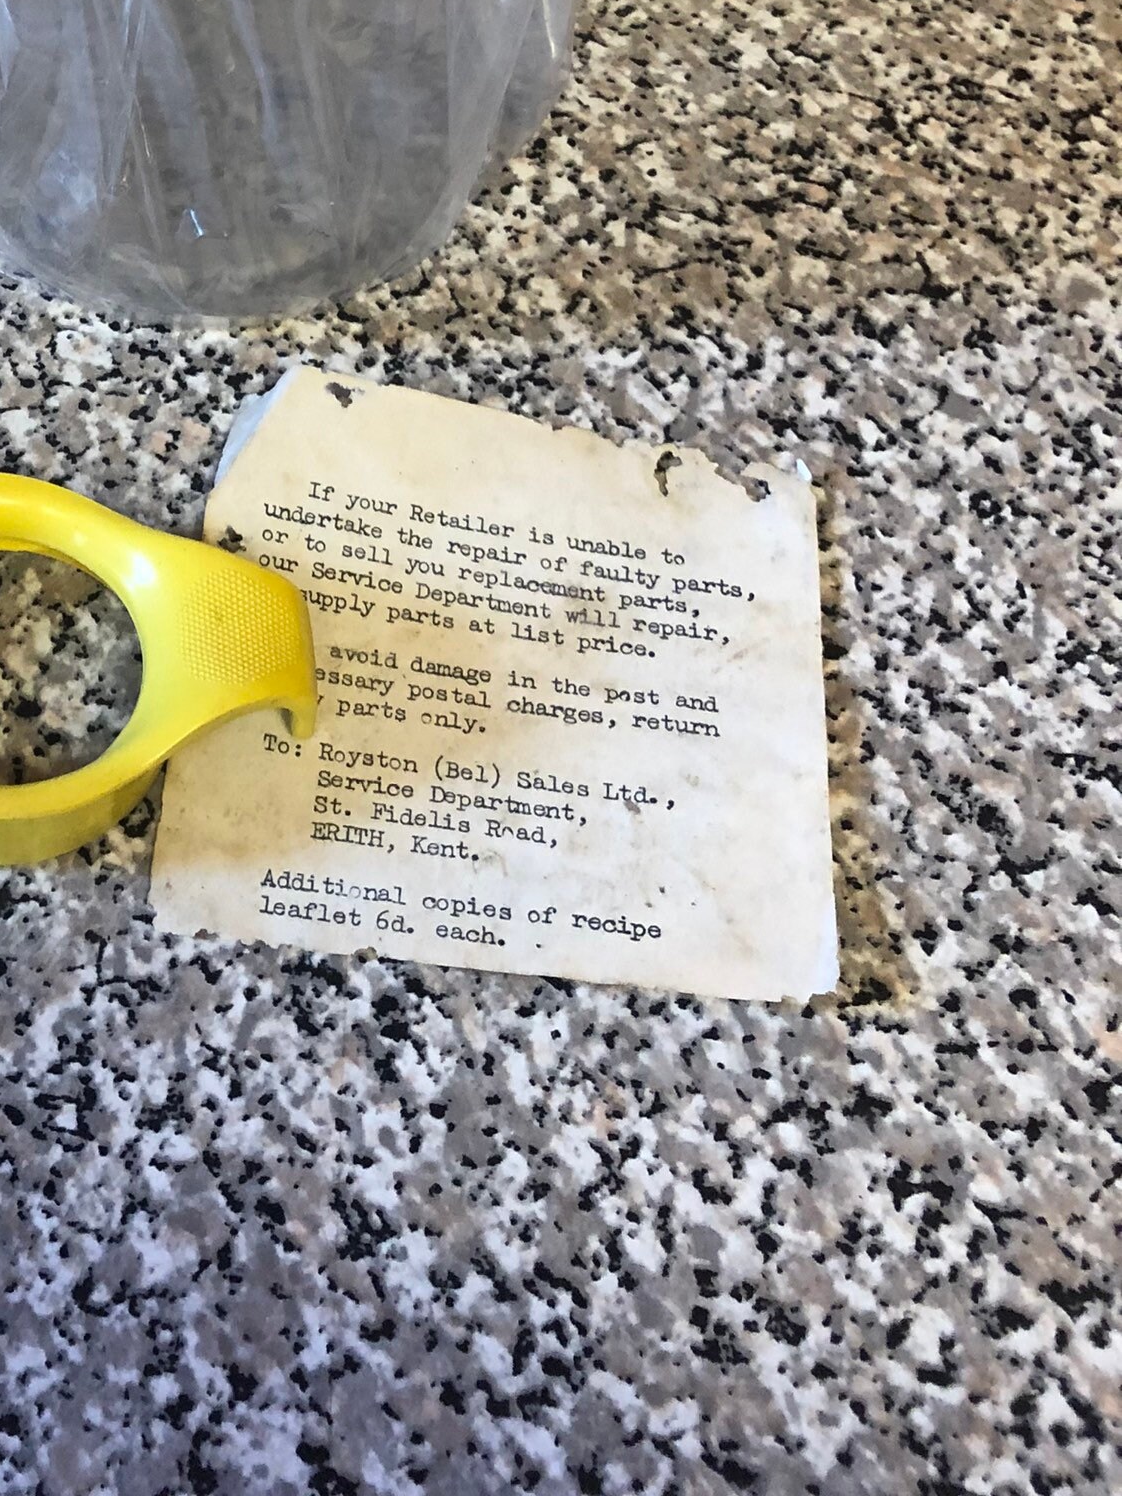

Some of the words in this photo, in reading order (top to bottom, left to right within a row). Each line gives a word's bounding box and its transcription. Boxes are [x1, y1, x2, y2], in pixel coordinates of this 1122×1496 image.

[264, 502, 382, 538] undertake
[397, 527, 433, 549] the
[446, 539, 527, 565] repair
[540, 557, 567, 572] of
[580, 560, 661, 589] faulty
[672, 577, 755, 602] parts,
[308, 482, 335, 502] If
[345, 493, 398, 515] your
[410, 504, 515, 537] Retailer
[529, 527, 554, 545] is
[566, 535, 647, 560] unable
[661, 548, 685, 566] to
[259, 554, 299, 573] our
[311, 561, 404, 594] Service
[415, 582, 551, 619] Department
[566, 608, 621, 629] will
[632, 618, 730, 645] repair,
[262, 529, 289, 545] or
[305, 535, 326, 553] to
[341, 543, 393, 566] sell
[405, 557, 445, 577] you
[458, 567, 605, 602] replacement
[618, 594, 699, 618] parts,
[386, 605, 454, 629] parts
[469, 618, 495, 635] at
[511, 622, 564, 645] list
[578, 635, 656, 658] price.
[330, 646, 398, 669] avoid
[410, 656, 492, 685] damage
[508, 671, 537, 690] in
[552, 677, 591, 697] the
[604, 686, 660, 705] post
[675, 694, 719, 713] and
[336, 698, 407, 722] parts
[421, 711, 486, 734] only.
[407, 682, 491, 708] postal
[507, 696, 616, 729] charges,
[631, 712, 720, 738] return
[263, 733, 302, 757] To:
[318, 742, 418, 774] Royston
[434, 755, 501, 789] (Bel)
[516, 771, 590, 797] Sales
[313, 795, 352, 816] St.
[370, 802, 470, 833] Fidelis
[317, 770, 414, 799] Service
[429, 785, 586, 826] Department,
[310, 821, 395, 854] ERITH,
[410, 835, 480, 862] Kent.
[259, 895, 362, 927] leaflet
[377, 910, 415, 934] 6d.
[436, 924, 506, 947] each.
[260, 869, 406, 905] Additional
[422, 895, 512, 921] copies
[528, 906, 557, 925] of
[571, 911, 662, 942] recipe
